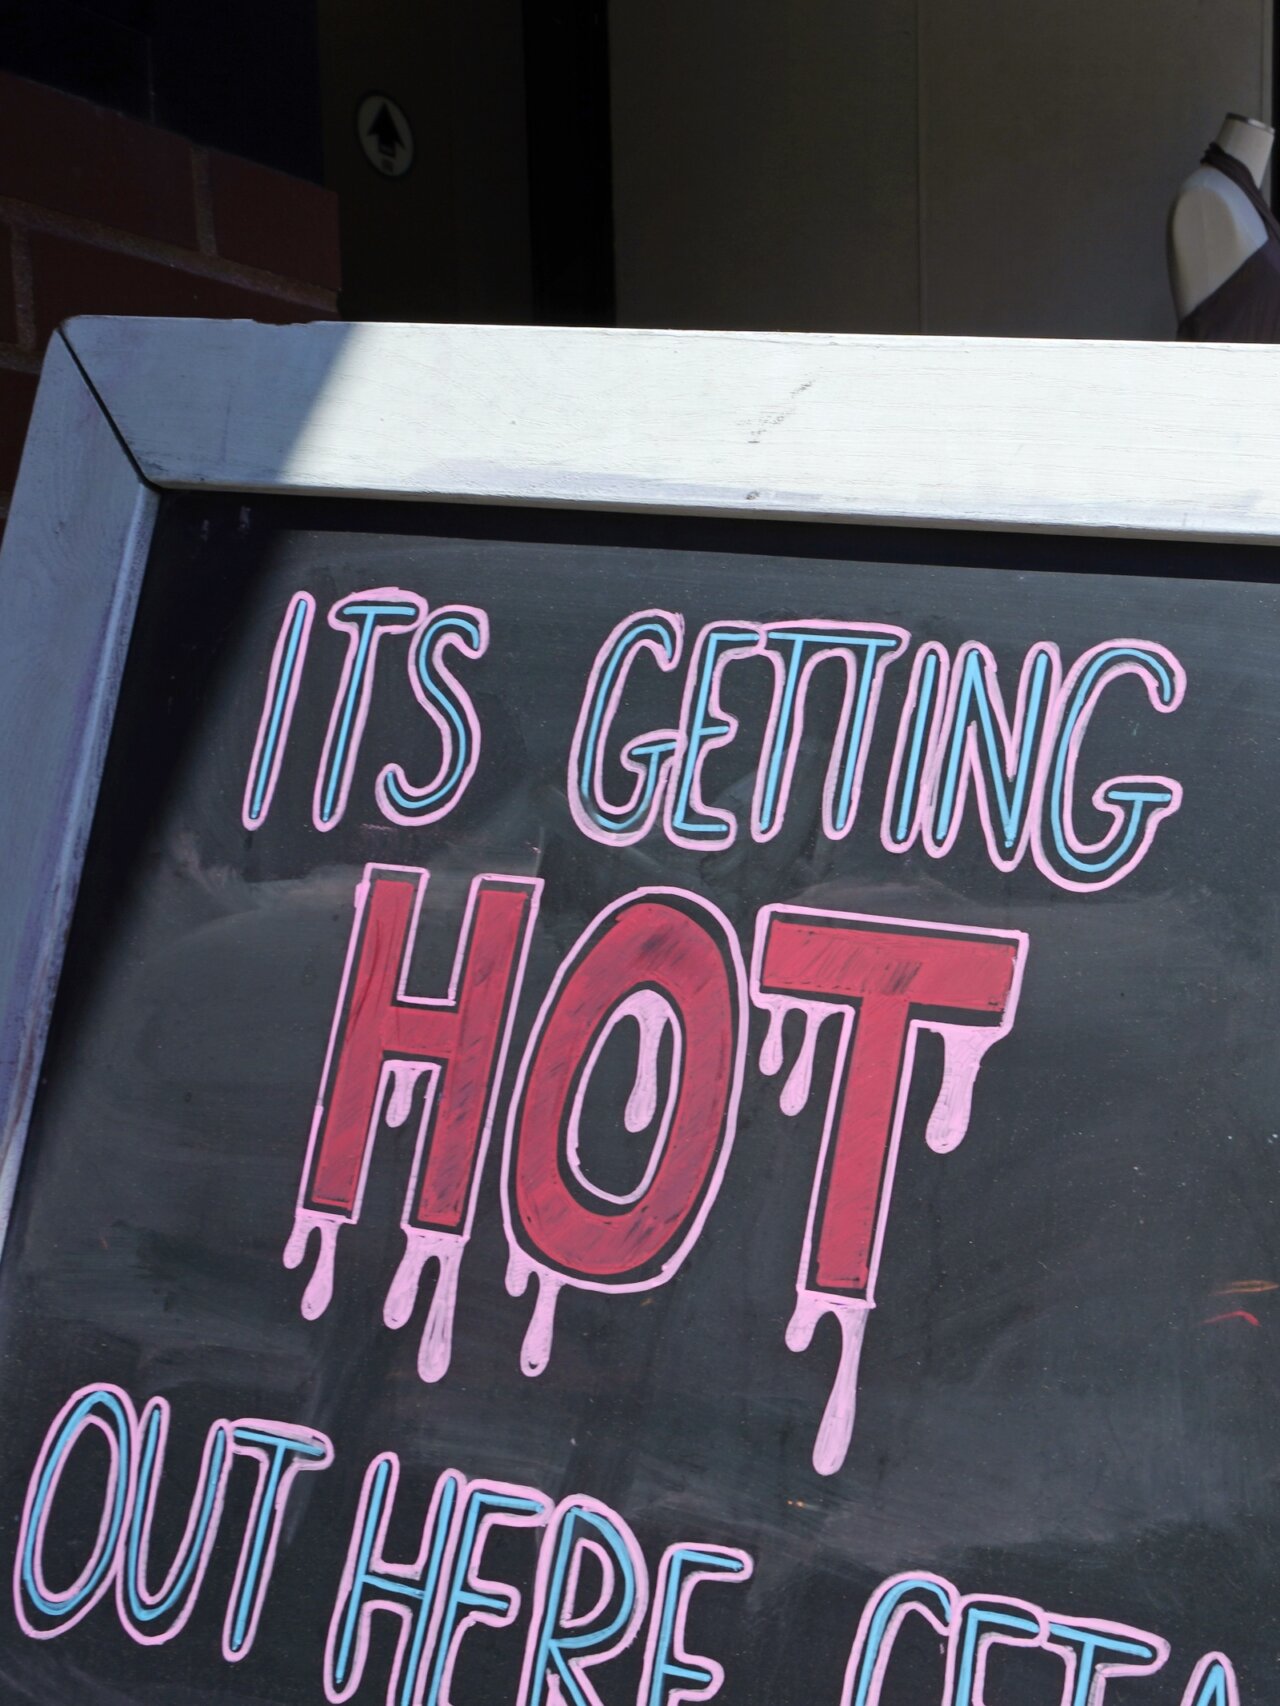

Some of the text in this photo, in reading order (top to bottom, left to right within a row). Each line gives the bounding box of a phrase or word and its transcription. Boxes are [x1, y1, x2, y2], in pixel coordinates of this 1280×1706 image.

[242, 586, 1187, 892] ITS GETTING
[288, 862, 1030, 1385] HOT
[13, 1382, 335, 1662] OUT
[323, 1451, 754, 1706] HERE
